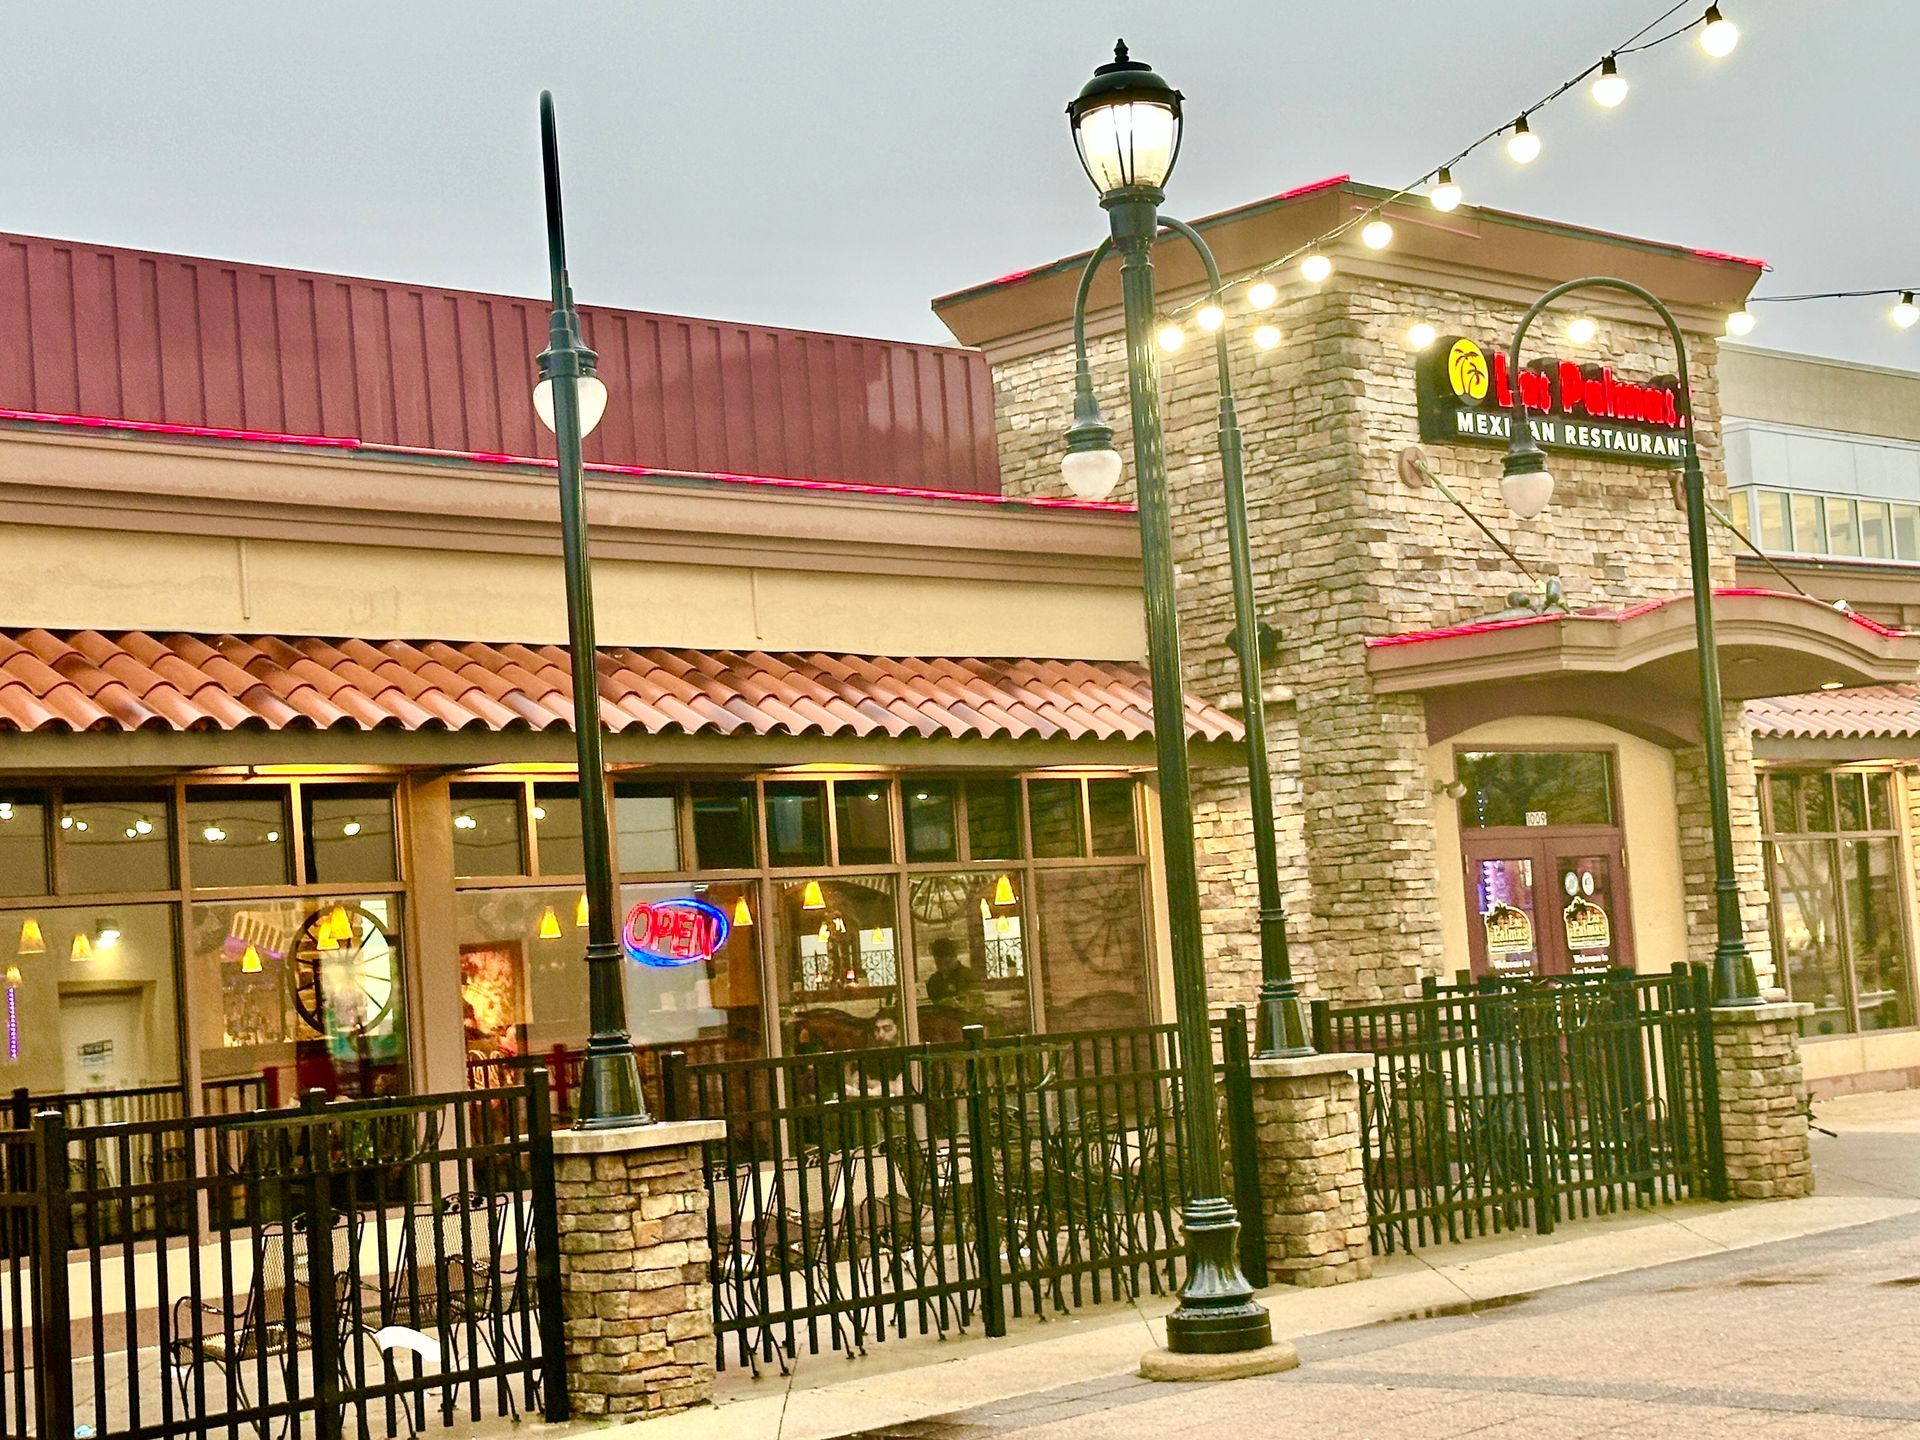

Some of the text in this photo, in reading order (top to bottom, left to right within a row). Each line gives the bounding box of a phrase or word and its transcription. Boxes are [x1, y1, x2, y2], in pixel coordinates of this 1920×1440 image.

[1493, 351, 1552, 415] Las
[1559, 359, 1677, 428] Palmas
[1456, 411, 1689, 458] MEXIAN RESTAURANT
[626, 902, 719, 960] OPEN
